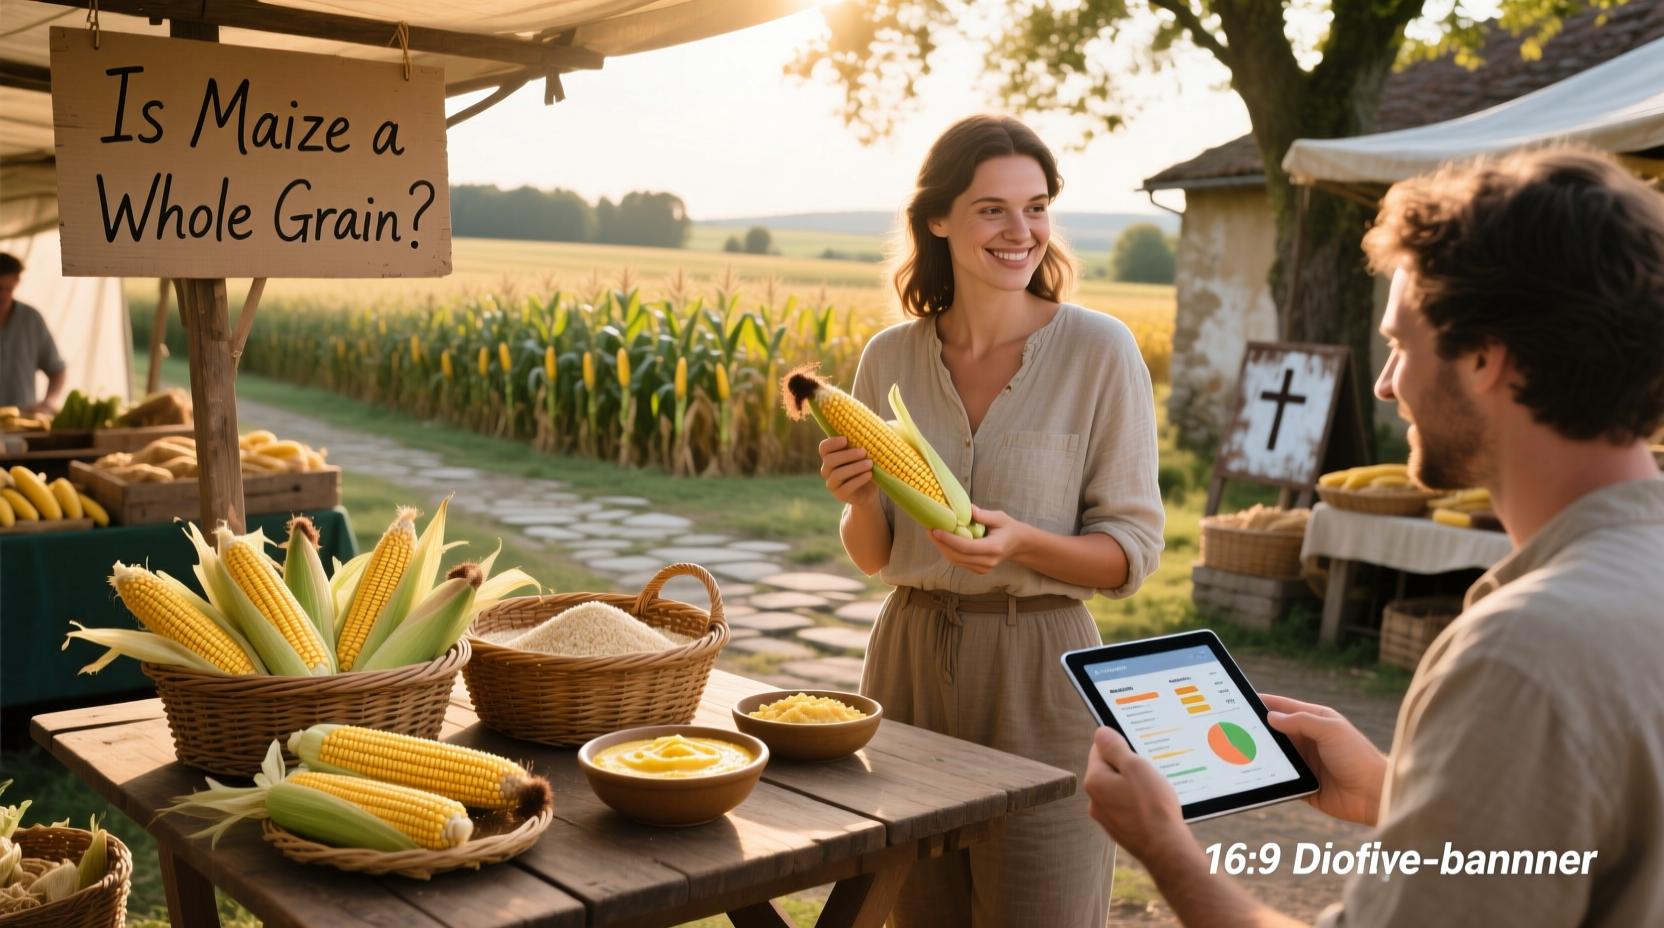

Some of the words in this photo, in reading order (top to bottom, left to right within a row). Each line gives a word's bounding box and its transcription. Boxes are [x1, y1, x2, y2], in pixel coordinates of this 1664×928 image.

[100, 65, 165, 145] Is
[189, 77, 351, 156] Maize
[372, 120, 406, 156] a
[95, 172, 253, 244] Whole
[273, 178, 436, 250] Grain?
